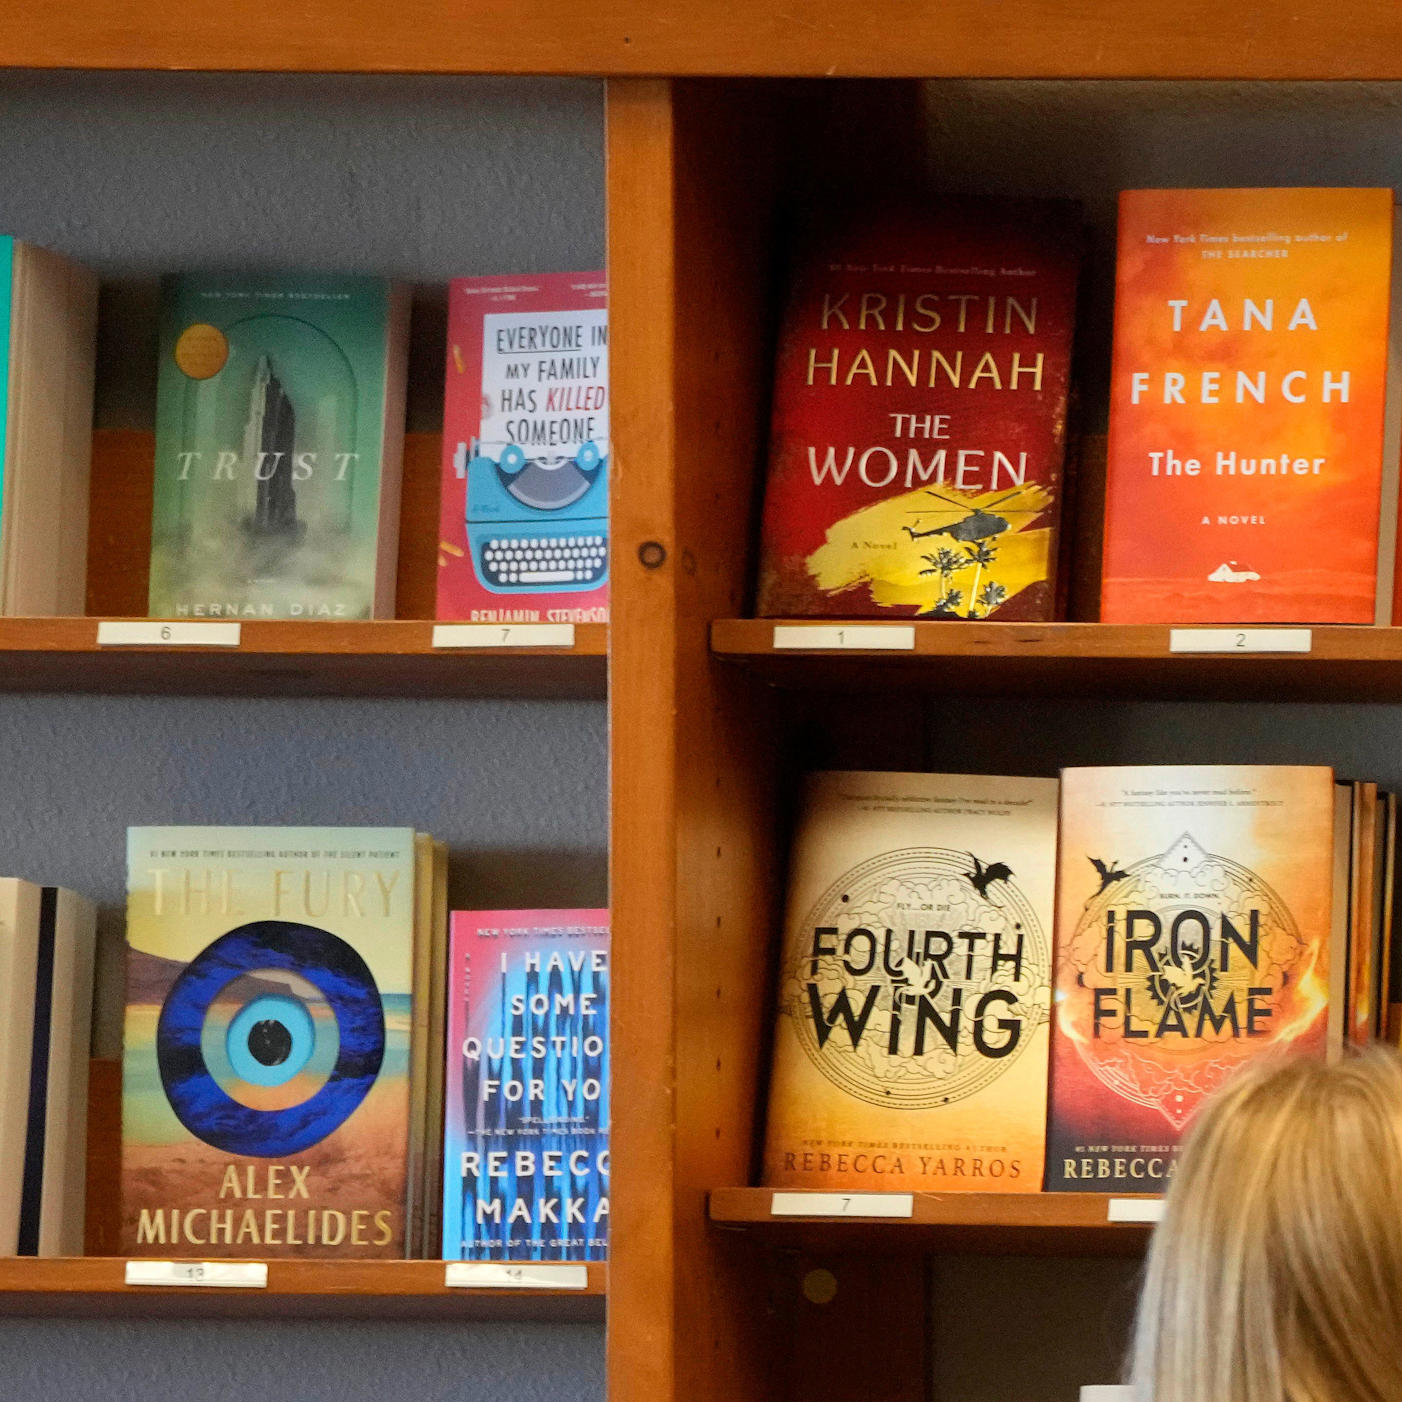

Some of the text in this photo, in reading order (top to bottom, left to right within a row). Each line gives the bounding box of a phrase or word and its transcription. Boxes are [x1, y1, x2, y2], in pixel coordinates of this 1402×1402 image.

[1146, 232, 1348, 245] New York Times bestselling author of
[821, 293, 1038, 334] KRISTIN
[1169, 298, 1318, 332] TANA
[496, 326, 583, 354] EVERYONE
[505, 358, 599, 382] MY FAMILY
[806, 348, 1045, 391] HANNAH
[500, 387, 605, 413] HAS KILLED
[1130, 370, 1352, 404] FRENCH
[505, 418, 596, 445] SOMEONE
[176, 451, 359, 481] TRUST
[806, 447, 1028, 491] WOMEN
[1148, 450, 1326, 476] The Hunter
[809, 926, 1025, 983] FOURTH
[510, 995, 598, 1016] SOME
[807, 982, 1023, 1059] WING
[784, 1152, 1023, 1179] REBECCA YARROS
[219, 1165, 311, 1199] ALEX
[136, 1209, 393, 1246] MICHAELIDES
